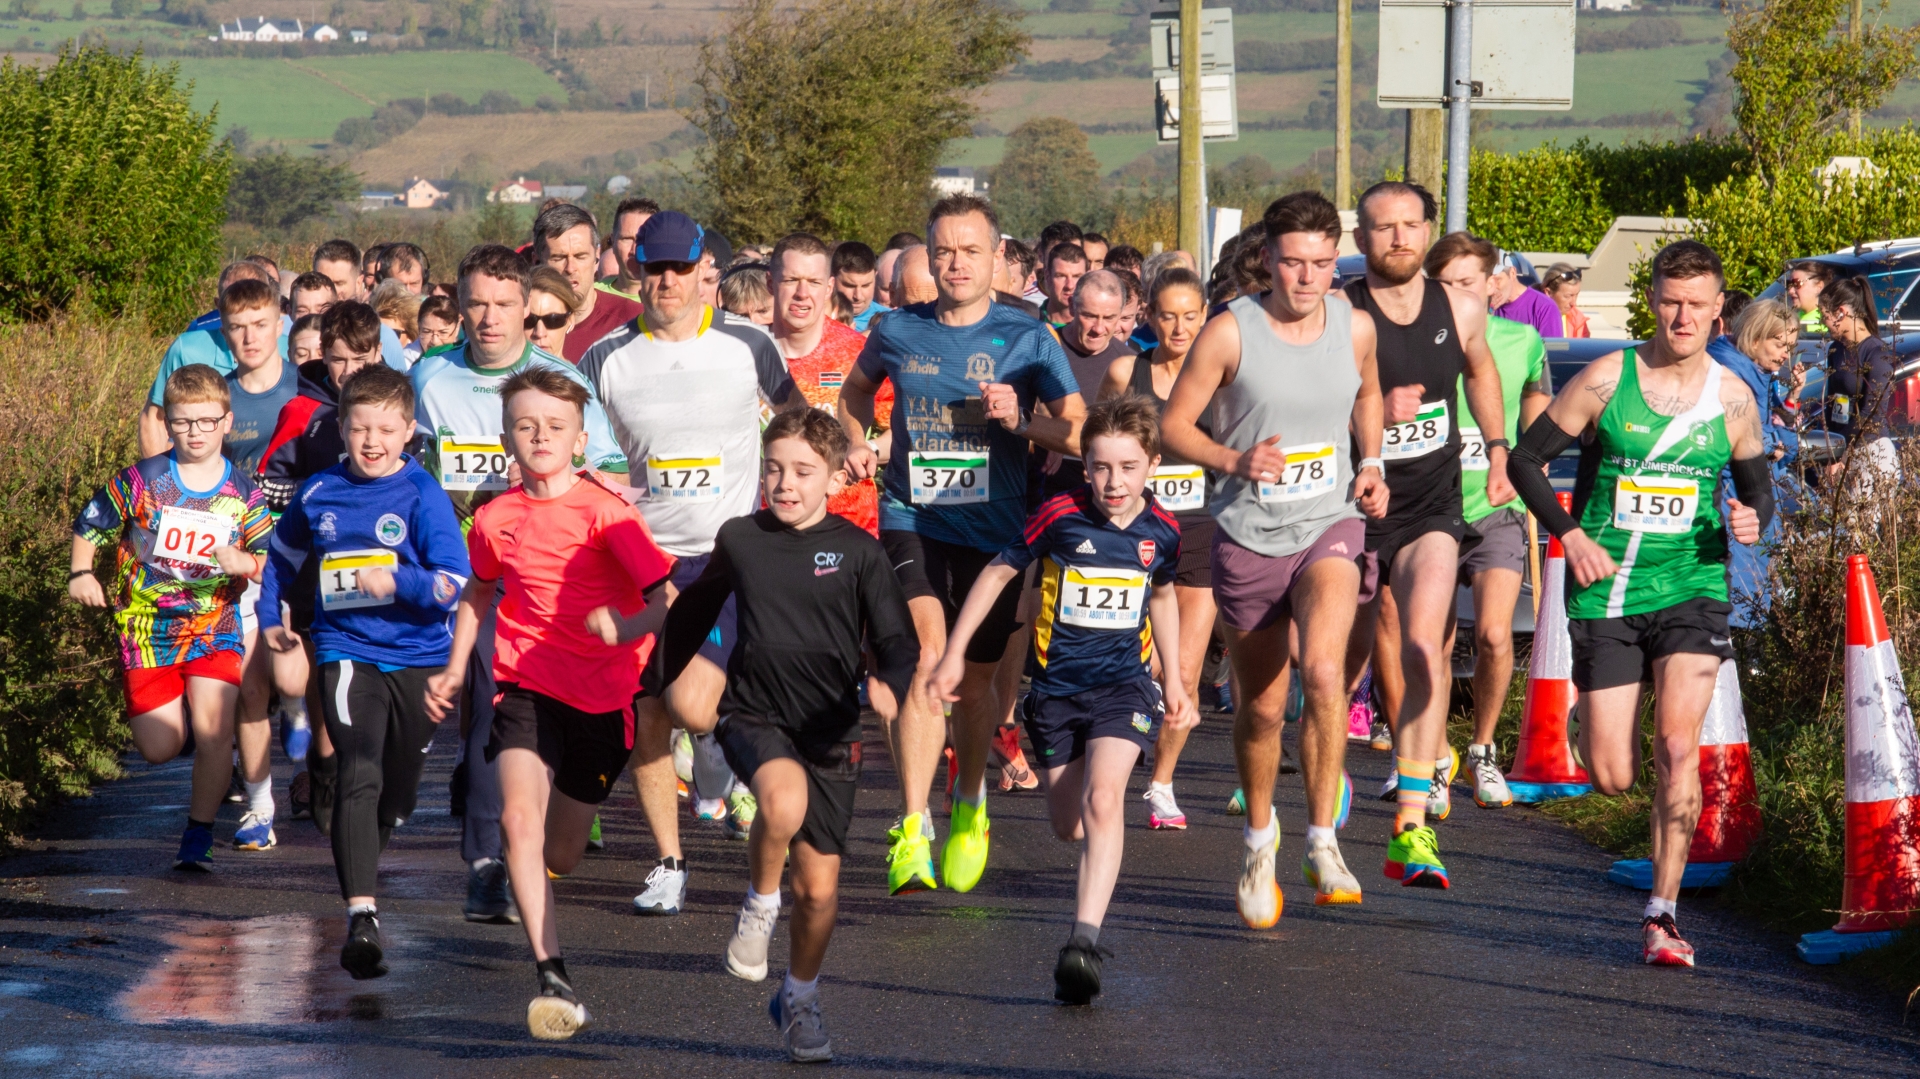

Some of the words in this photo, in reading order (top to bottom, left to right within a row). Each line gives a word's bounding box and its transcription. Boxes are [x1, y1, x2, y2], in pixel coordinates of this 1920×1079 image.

[1385, 420, 1437, 445] 328
[454, 453, 507, 474] 120
[1610, 454, 1639, 468] WEST
[1641, 461, 1695, 475] LIMERICK
[659, 468, 711, 488] 172
[922, 468, 976, 488] 370
[1150, 479, 1193, 497] 109
[1630, 494, 1685, 517] 150
[164, 527, 216, 558] 012
[814, 551, 844, 567] CR7
[333, 569, 360, 592] 11
[1076, 586, 1130, 610] 121
[1089, 610, 1104, 619] ABOUT
[1105, 611, 1117, 620] TIME
